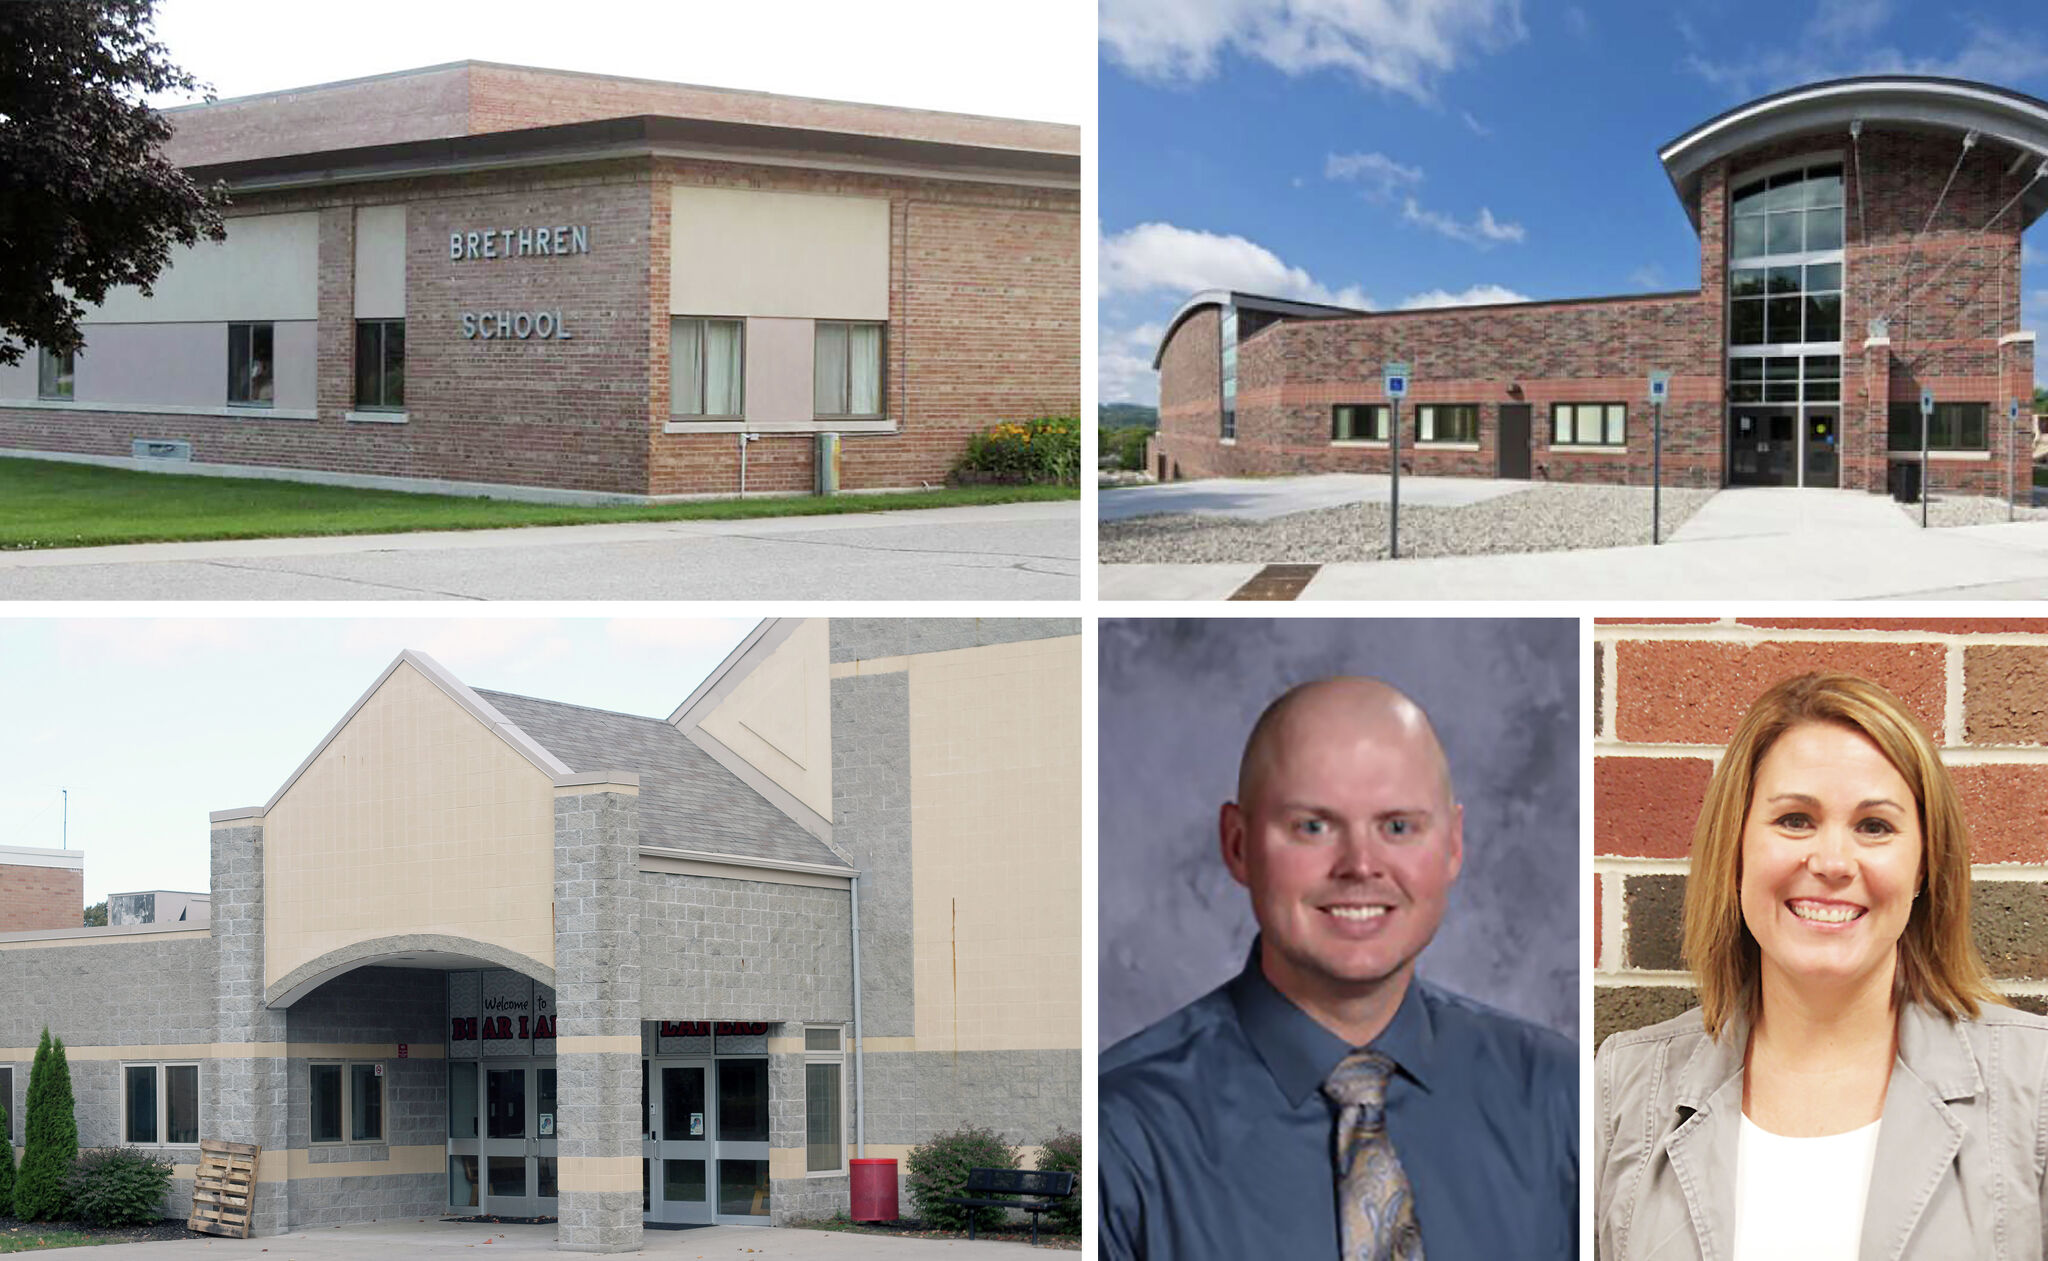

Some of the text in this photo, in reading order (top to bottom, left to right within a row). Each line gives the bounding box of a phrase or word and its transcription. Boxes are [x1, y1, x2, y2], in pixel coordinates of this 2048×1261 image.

[451, 225, 588, 260] BRETHREN
[462, 309, 572, 339] SCHOOL
[485, 995, 547, 1011] Welcome to
